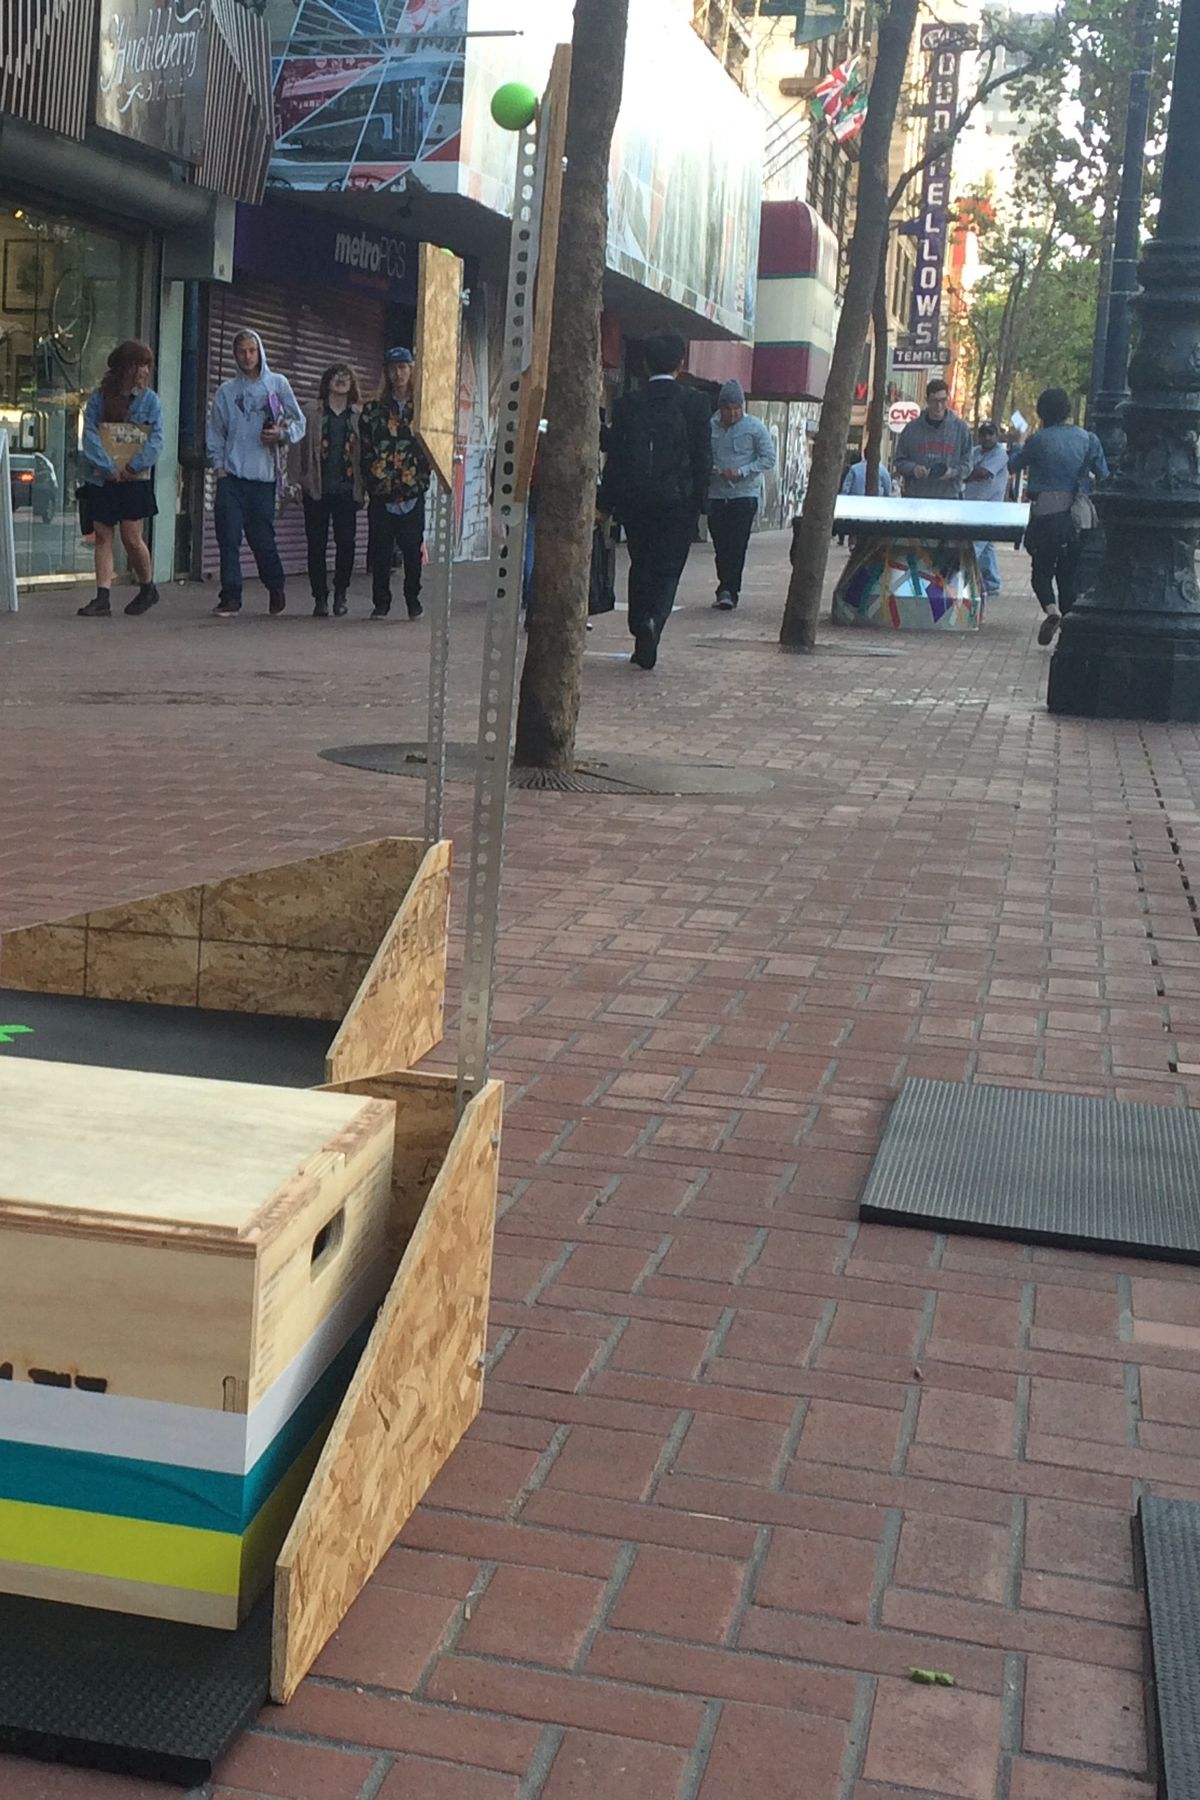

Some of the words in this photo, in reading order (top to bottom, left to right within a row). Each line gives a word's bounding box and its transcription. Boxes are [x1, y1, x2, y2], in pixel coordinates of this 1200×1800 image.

[100, 3, 204, 92] Huckleberry
[334, 231, 407, 279] metroPCS
[896, 350, 948, 362] TEMPLE
[890, 408, 919, 421] CVS
